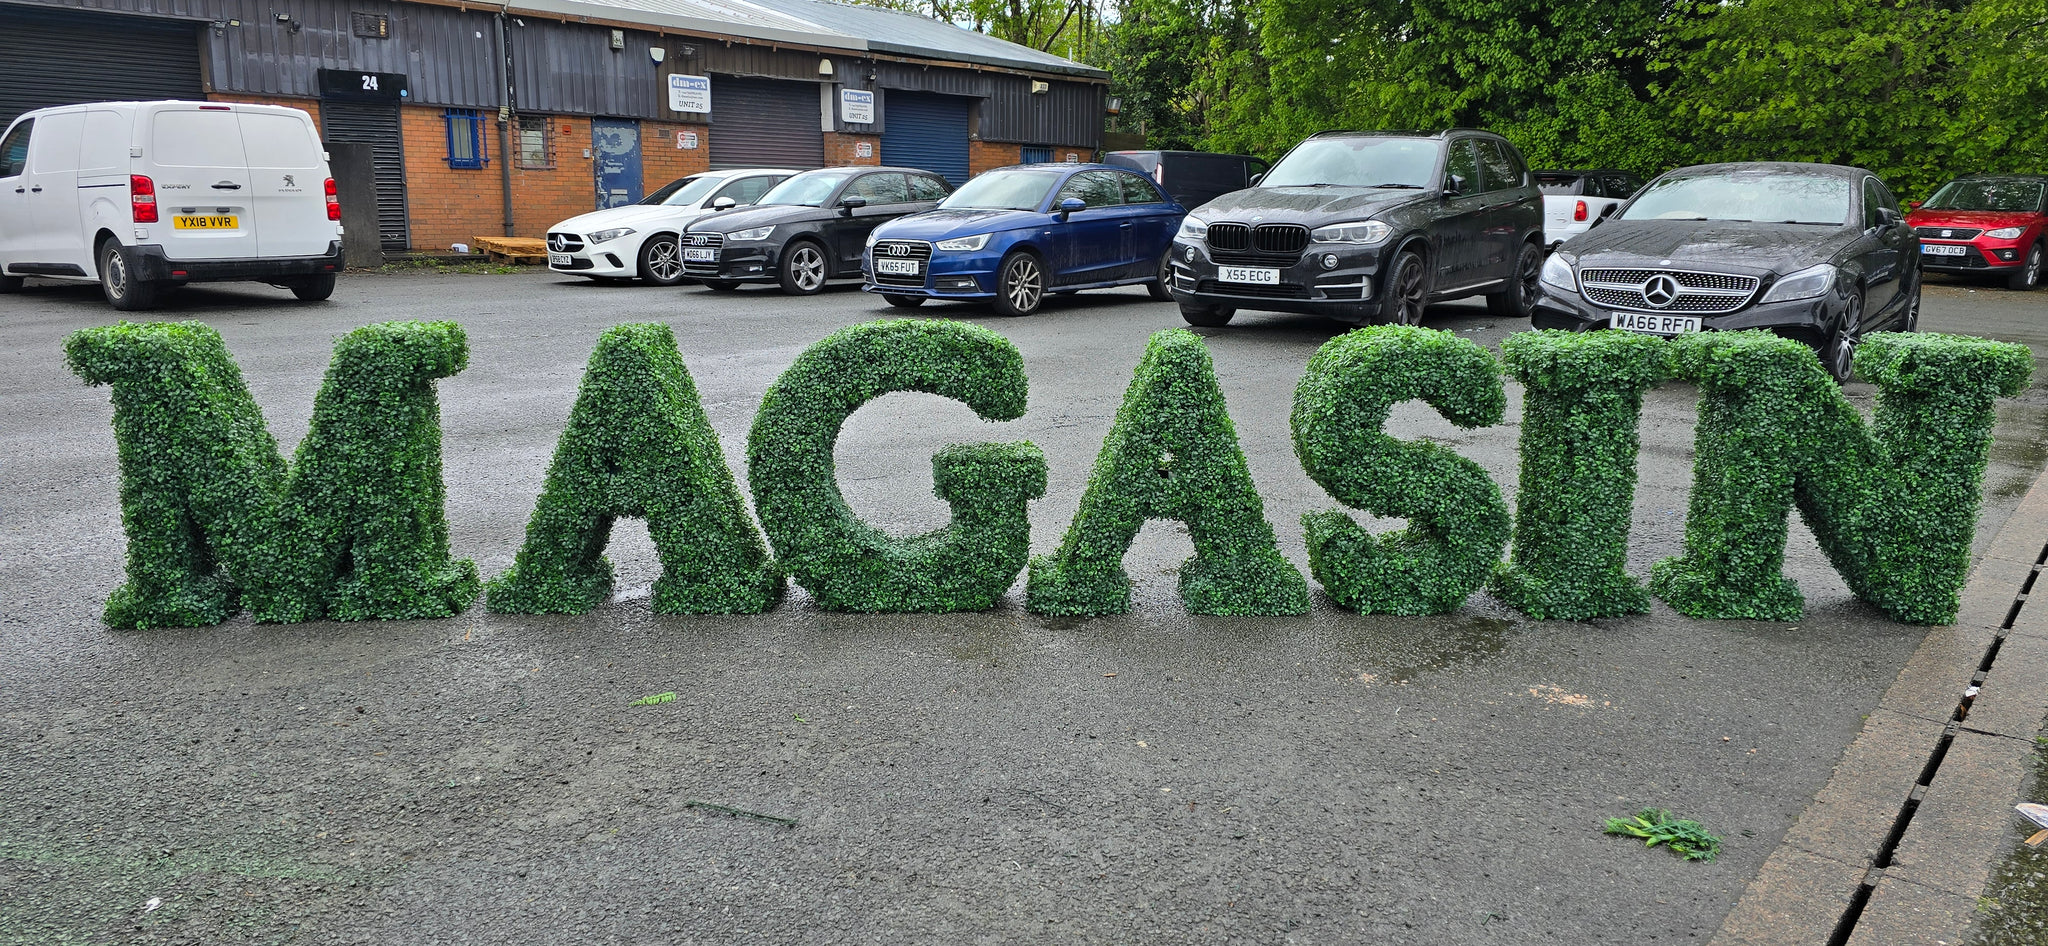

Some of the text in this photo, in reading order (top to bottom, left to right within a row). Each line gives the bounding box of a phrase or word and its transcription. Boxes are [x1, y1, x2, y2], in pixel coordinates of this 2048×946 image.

[362, 75, 378, 90] 24
[673, 77, 706, 89] dm-ex
[844, 92, 870, 102] dm-ex
[180, 217, 231, 227] YX18 VVR
[700, 250, 712, 259] LJY
[1925, 245, 1946, 254] GV67
[881, 261, 915, 273] VK65 FUT
[1226, 269, 1271, 282] X55 ECG
[1616, 314, 1657, 330] WA66
[62, 320, 2033, 630] MAGASIN
